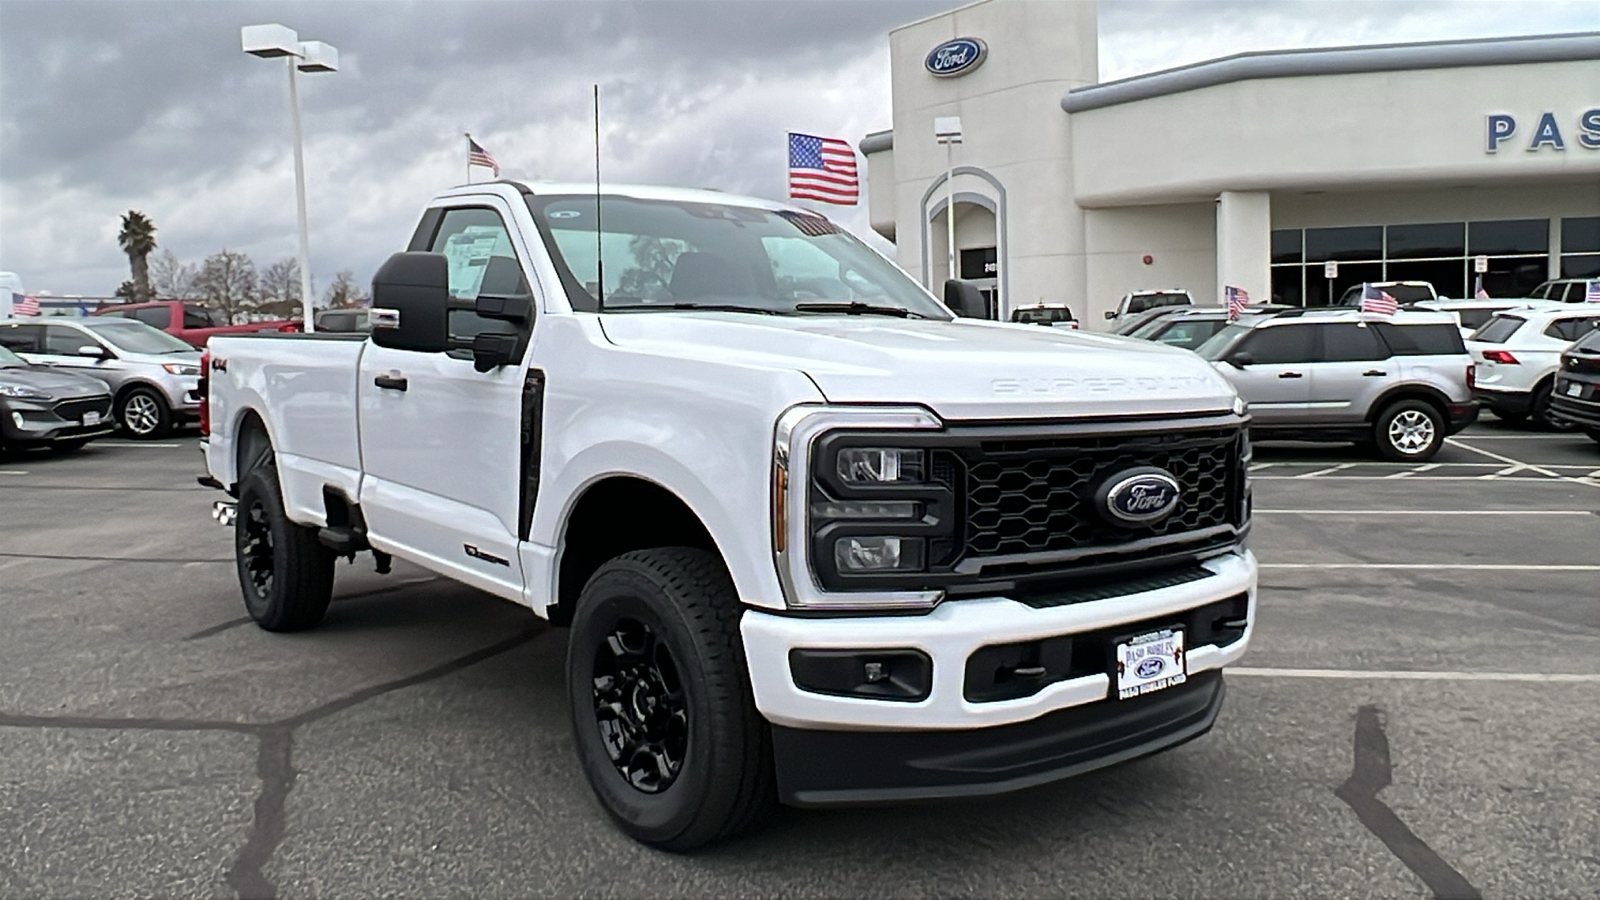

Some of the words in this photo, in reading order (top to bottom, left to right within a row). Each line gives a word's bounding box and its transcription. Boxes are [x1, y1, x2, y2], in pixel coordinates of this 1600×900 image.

[934, 45, 968, 70] Ford
[990, 376, 1126, 393] SUPER
[1127, 484, 1165, 512] Ford
